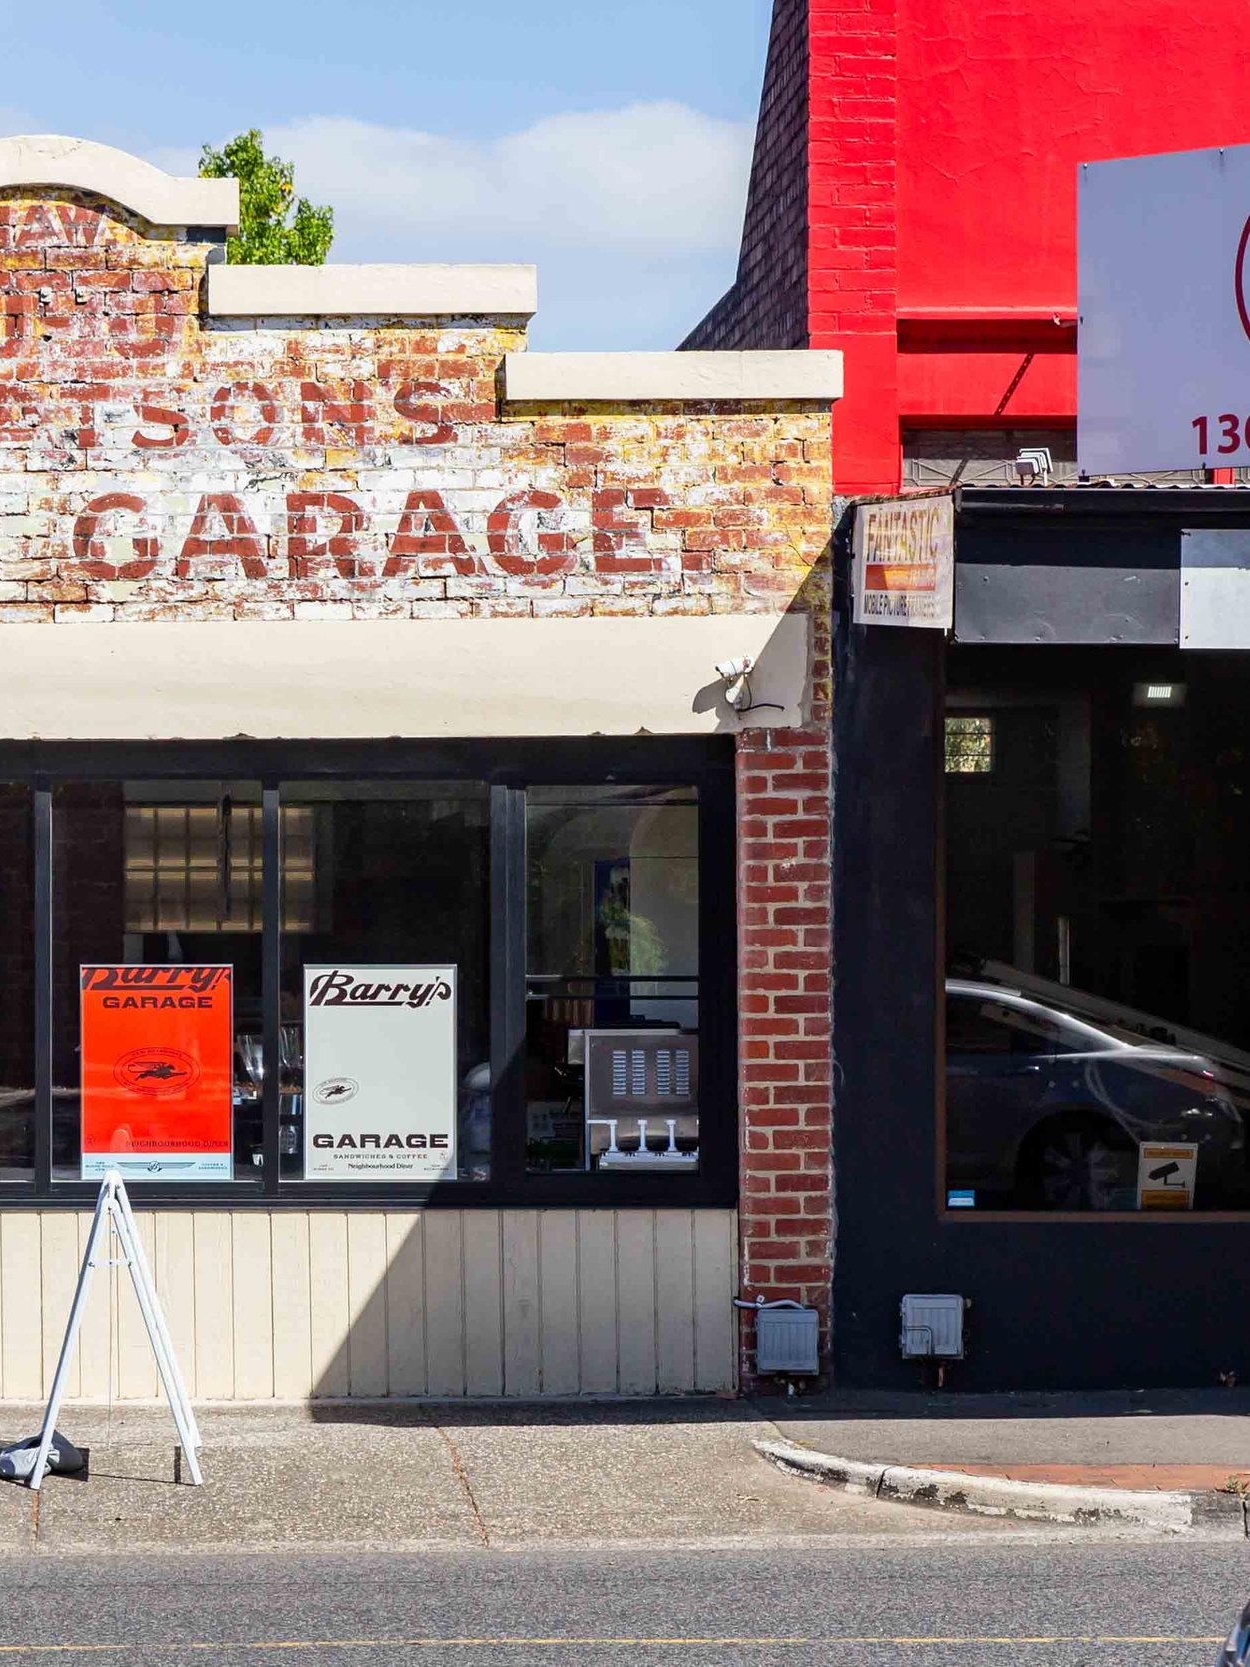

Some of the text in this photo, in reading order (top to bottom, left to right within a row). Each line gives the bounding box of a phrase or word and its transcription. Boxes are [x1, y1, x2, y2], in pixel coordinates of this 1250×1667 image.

[1191, 413, 1250, 456] 13
[71, 487, 672, 581] GARAGE
[866, 506, 940, 563] FANTASTIC
[102, 996, 213, 1009] GARAGE
[309, 969, 452, 1009] Barry's
[312, 1133, 449, 1149] GARAGE
[347, 1162, 396, 1171] Neighbourhood
[396, 1162, 414, 1170] Diner
